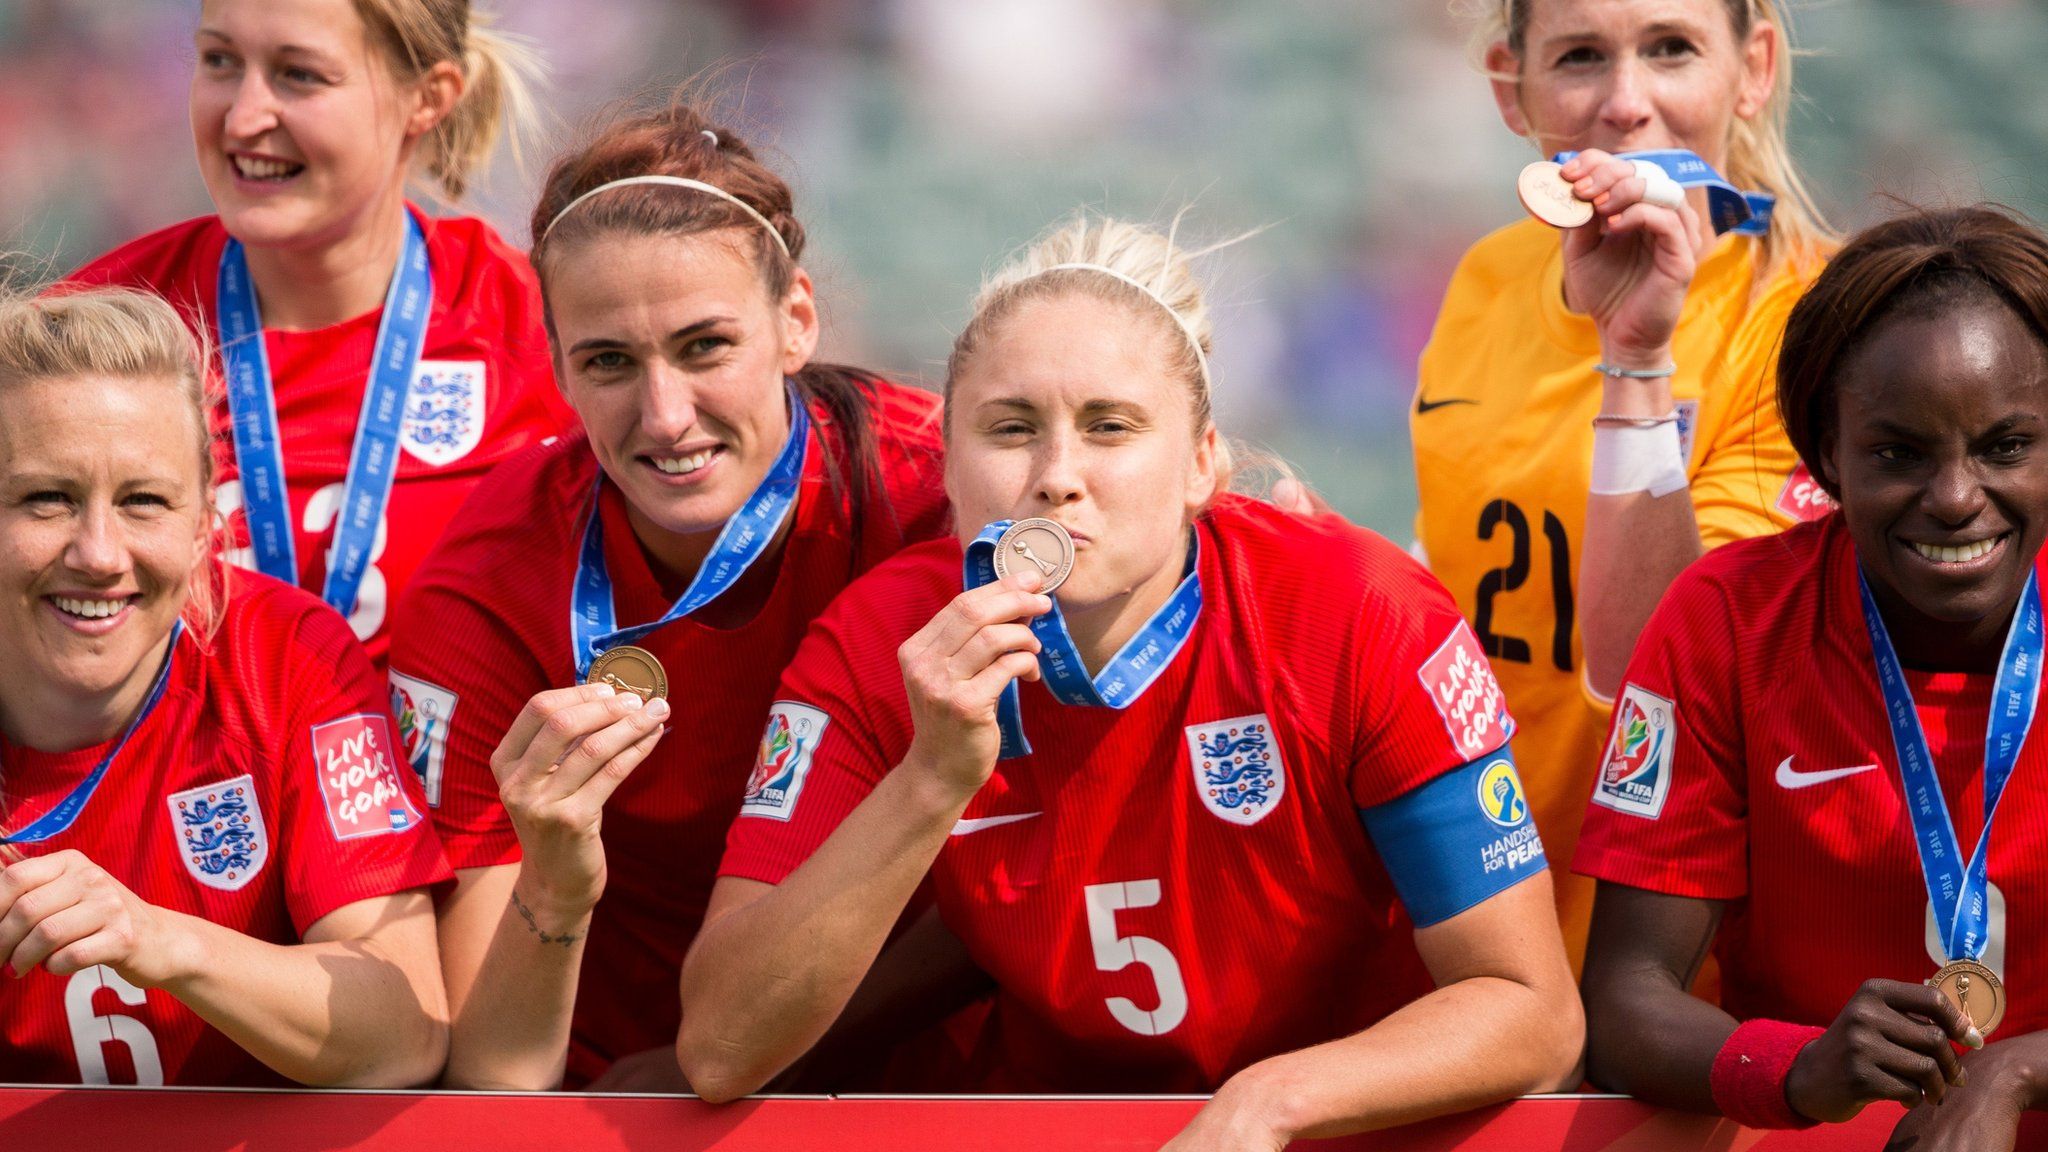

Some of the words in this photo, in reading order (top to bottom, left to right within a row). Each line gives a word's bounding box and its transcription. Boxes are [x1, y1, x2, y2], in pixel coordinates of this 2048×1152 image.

[754, 488, 778, 519] FIFA
[731, 527, 755, 555] FIFA
[711, 561, 732, 584] FIFA
[1475, 498, 1573, 672] 21
[2027, 604, 2037, 634] FIFA
[1048, 648, 1069, 679] FIFA
[1100, 677, 1125, 703] FIFA
[1130, 639, 1159, 670] FIFA
[1164, 604, 1187, 634] FIFA
[2014, 647, 2029, 677] FIFA
[1440, 645, 1470, 703] LIVE
[1451, 660, 1487, 725] YOUR
[2006, 690, 2022, 717] FIFA
[327, 726, 377, 771] LIVE
[330, 752, 389, 797] YOUR
[1626, 781, 1652, 799] FIFA
[339, 774, 398, 824] GOALS
[762, 787, 784, 800] FIFA
[1906, 742, 1921, 773] FIFA
[1917, 786, 1932, 816] FIFA
[1928, 829, 1945, 858] FIFA
[1939, 872, 1956, 900] FIFA
[1484, 856, 1505, 874] FOR
[1971, 891, 1983, 921] FIFA
[1084, 879, 1188, 1035] 5
[64, 964, 163, 1086] 6
